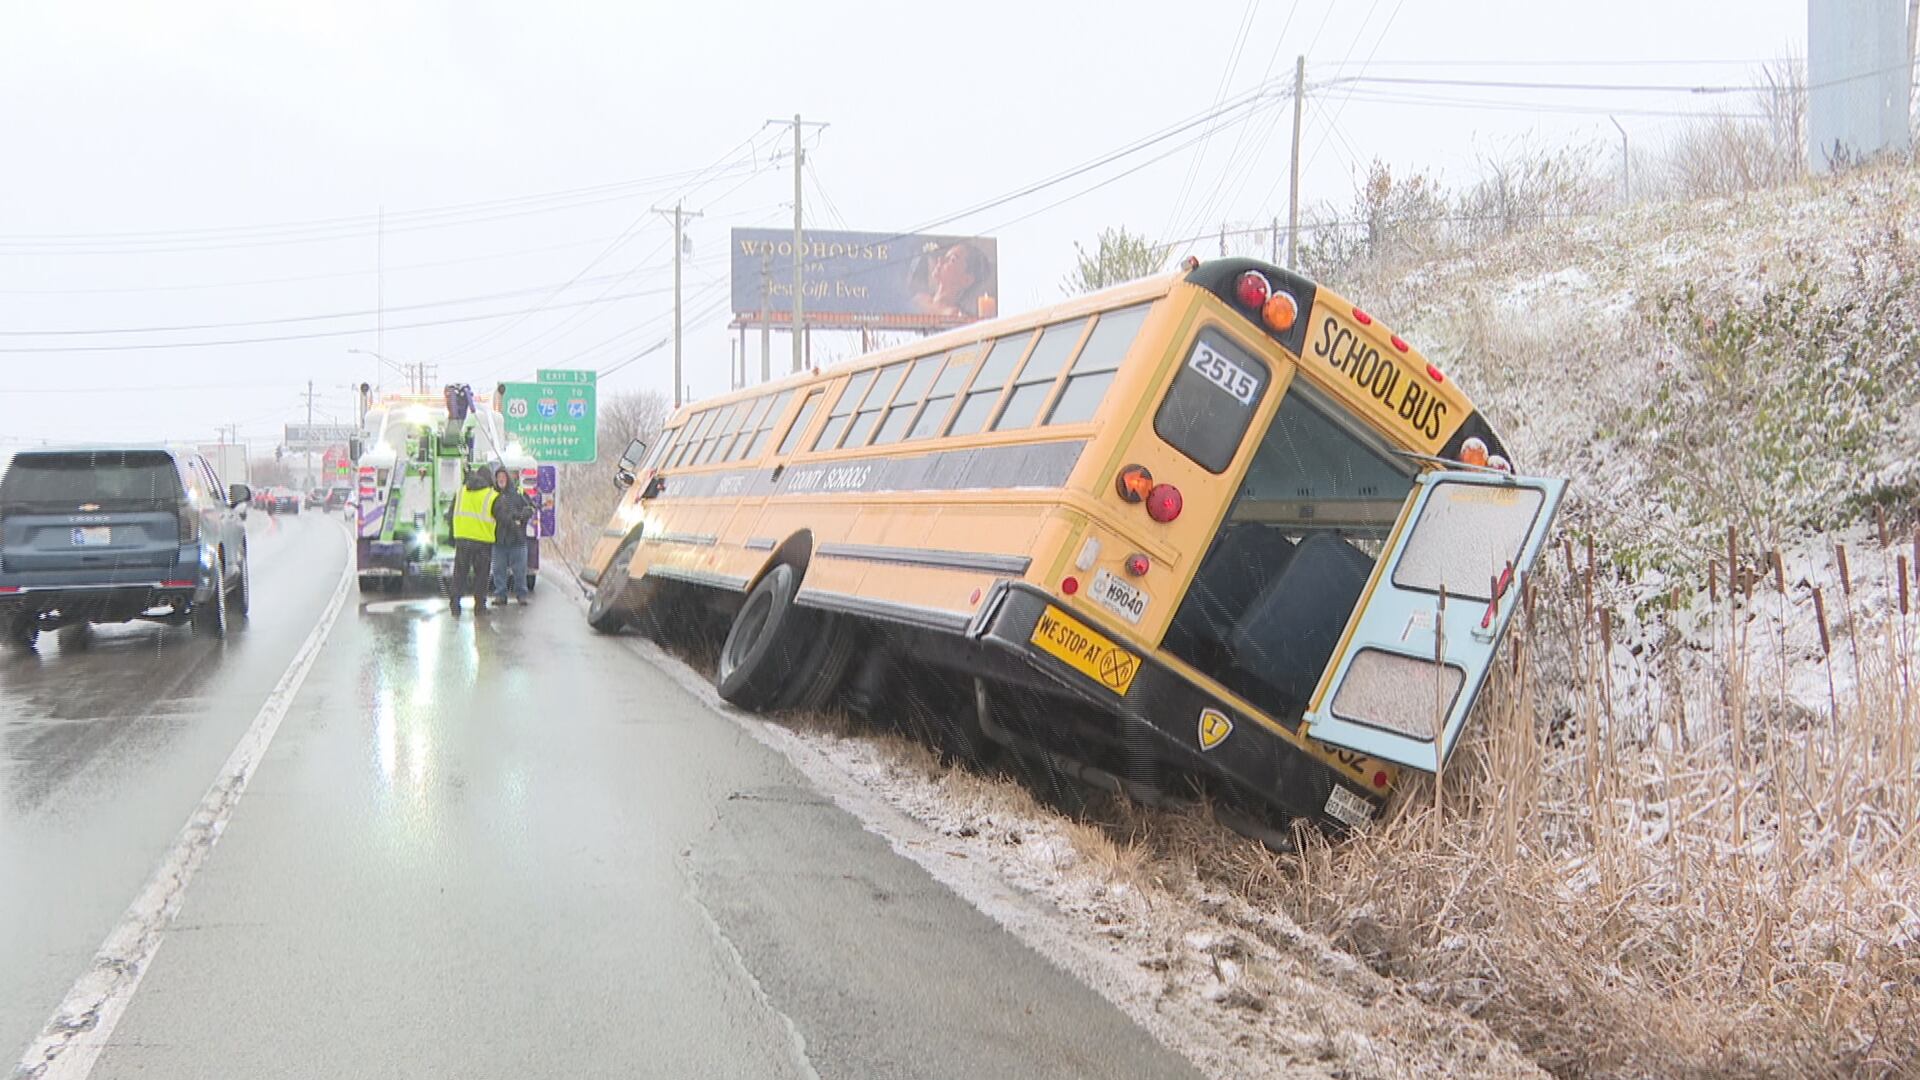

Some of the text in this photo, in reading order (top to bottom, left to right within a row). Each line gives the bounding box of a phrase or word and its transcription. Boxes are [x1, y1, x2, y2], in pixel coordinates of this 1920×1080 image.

[803, 262, 824, 272] SPA
[545, 372, 588, 382] EXIT 13
[1194, 349, 1253, 399] 2515
[1314, 317, 1447, 440] SCHOOL BUS
[572, 388, 583, 396] TO
[510, 402, 584, 417] 60 75 64
[518, 423, 576, 434] Lexington
[524, 436, 580, 445] inchester
[546, 448, 568, 456] MILE
[788, 465, 871, 491] COUNTY SCHOOLS
[1039, 615, 1102, 664] WE STOP AT
